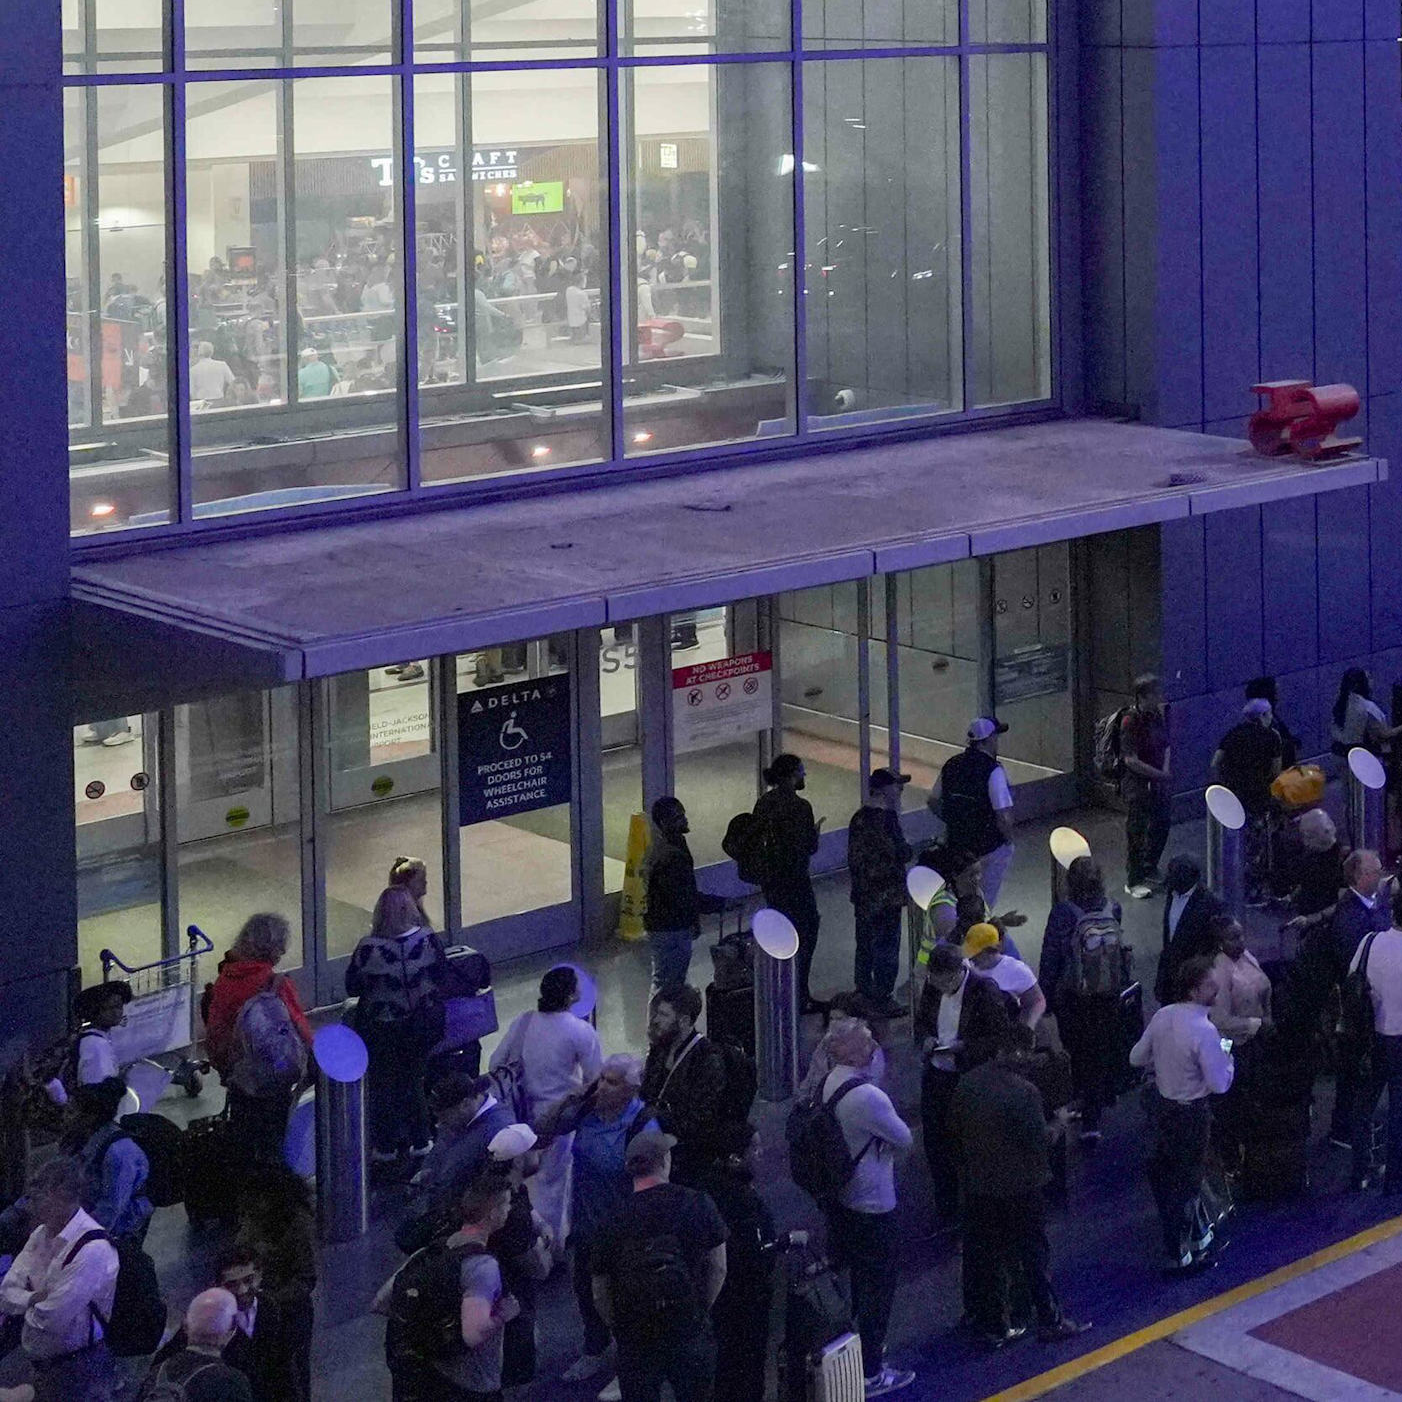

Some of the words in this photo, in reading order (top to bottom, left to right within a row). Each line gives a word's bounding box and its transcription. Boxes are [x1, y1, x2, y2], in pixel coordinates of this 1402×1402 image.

[685, 676, 697, 685] AT
[699, 663, 760, 682] CHECKPOINTS
[692, 664, 706, 674] NO
[708, 655, 753, 671] WEAPONS
[488, 688, 541, 709] DELTA
[477, 756, 522, 775] PROCEED
[523, 754, 538, 766] TO
[487, 769, 522, 785] DOORS
[523, 765, 543, 778] FOR
[483, 776, 548, 798] WHEELCHAIR
[486, 788, 546, 810] ASSISTANCE
